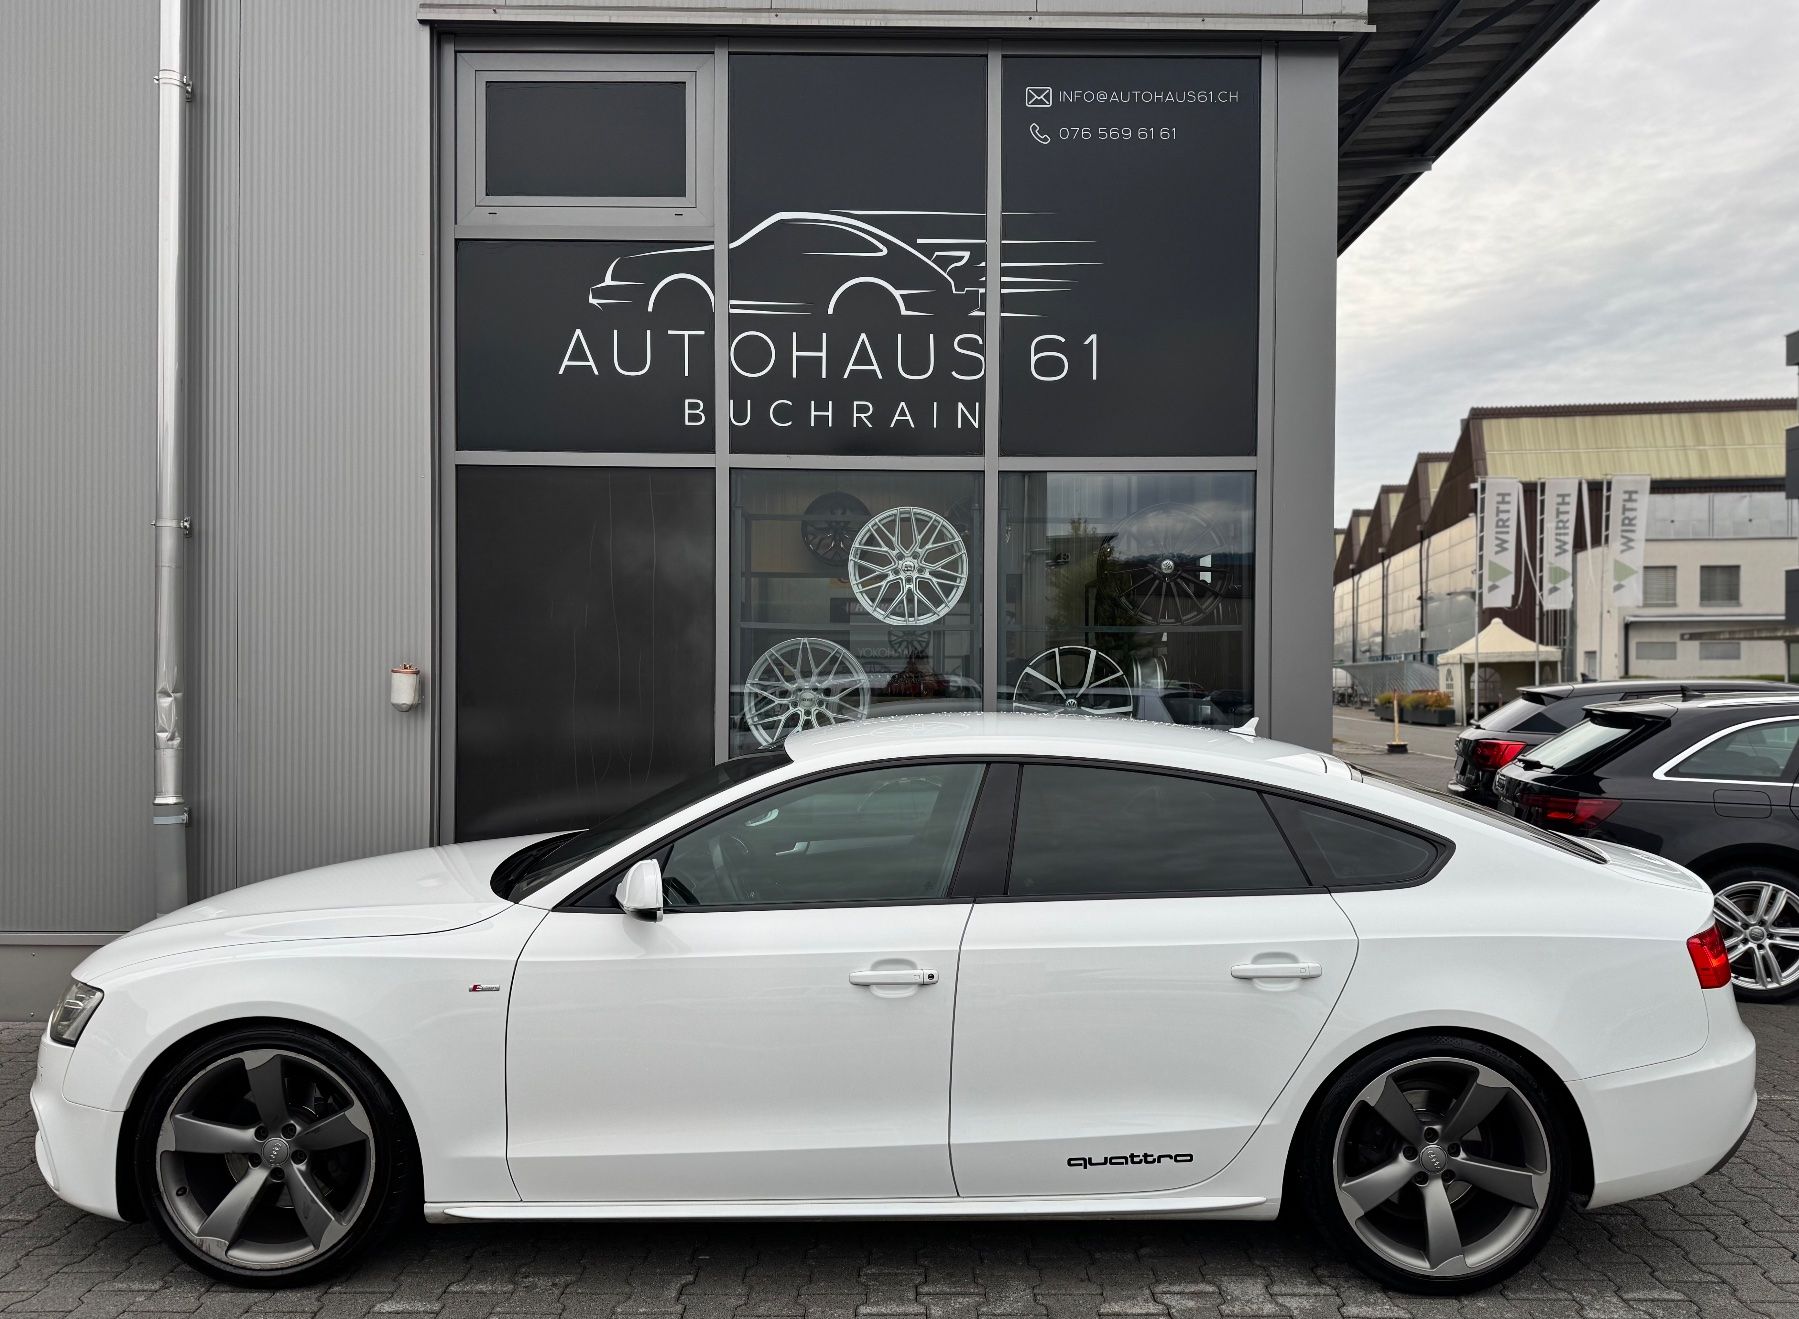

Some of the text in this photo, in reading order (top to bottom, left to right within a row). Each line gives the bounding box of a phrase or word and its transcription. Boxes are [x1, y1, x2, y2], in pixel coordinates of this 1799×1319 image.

[1058, 90, 1239, 104] INFO@AUTOHAUS61.CH
[1058, 127, 1176, 140] 076 569 61 61
[558, 328, 1098, 382] AUTOHAUS 61
[684, 398, 980, 429] BUCHRAIN
[1494, 492, 1511, 555] WIRTH
[1555, 493, 1571, 557] WIRTH
[1620, 489, 1639, 553] WIRTH
[1066, 1152, 1194, 1170] quattro
